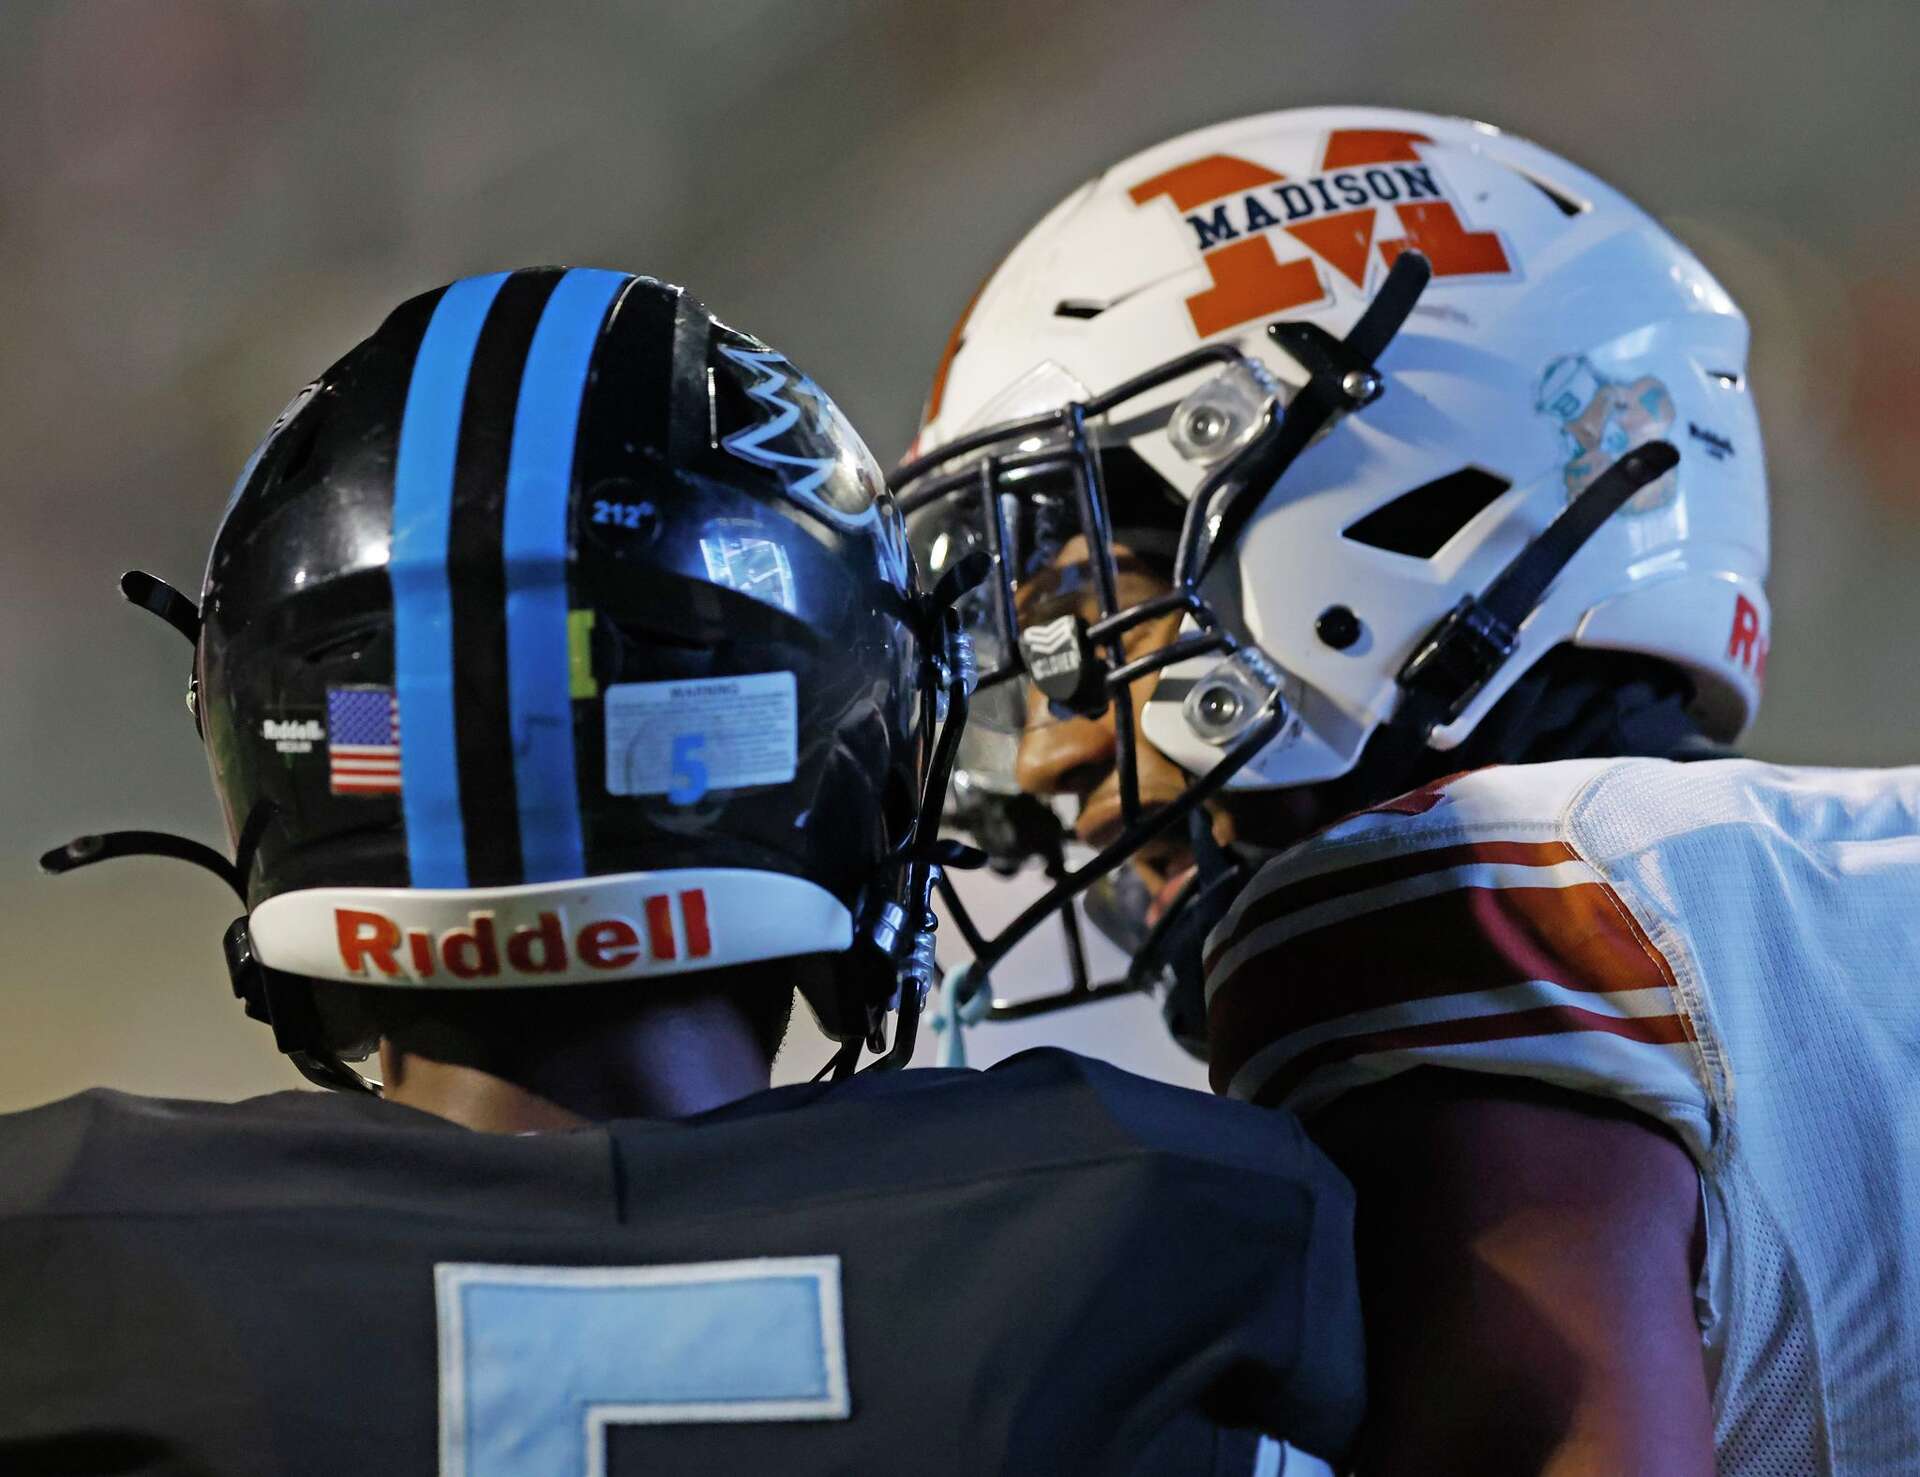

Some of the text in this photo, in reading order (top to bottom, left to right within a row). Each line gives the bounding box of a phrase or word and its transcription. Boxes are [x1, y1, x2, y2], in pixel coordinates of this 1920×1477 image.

[1186, 164, 1441, 250] MADISON
[667, 731, 710, 807] 5
[334, 887, 712, 979] Riddell
